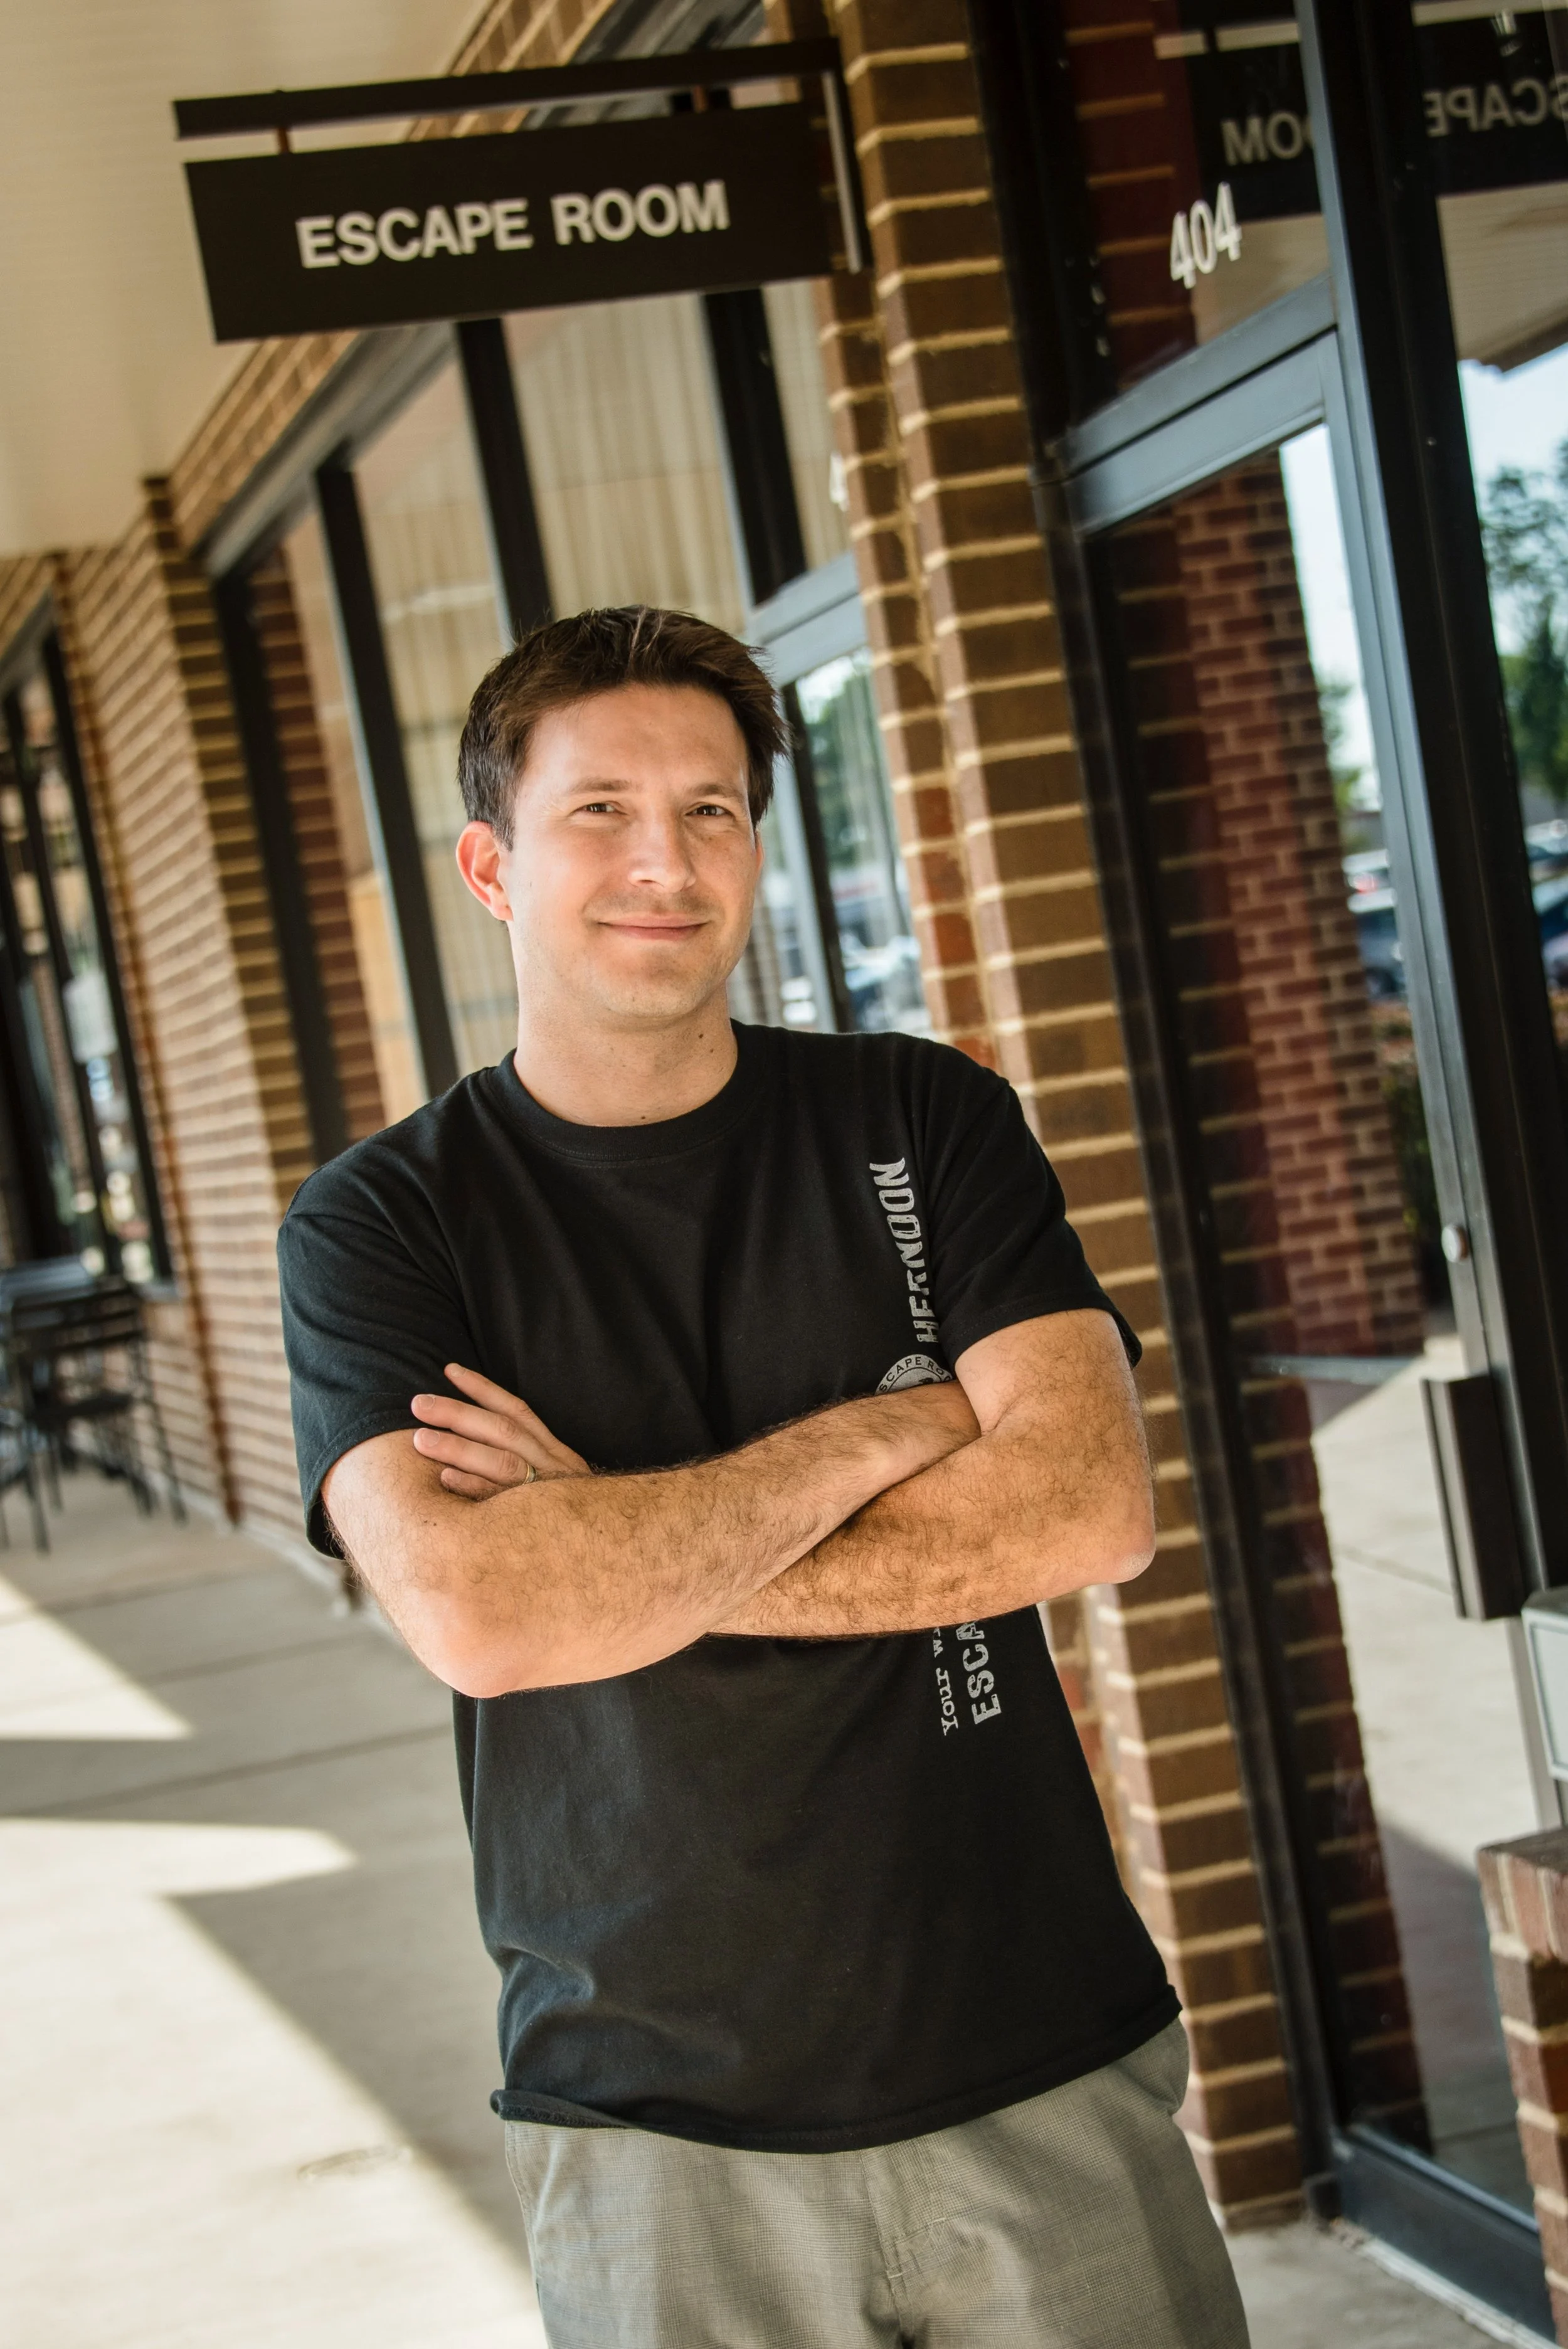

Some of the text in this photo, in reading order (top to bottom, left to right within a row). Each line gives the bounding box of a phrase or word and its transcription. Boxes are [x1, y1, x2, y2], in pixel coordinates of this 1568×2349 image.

[295, 179, 729, 269] ESCAPE ROOM
[1170, 182, 1242, 289] 404
[869, 1157, 940, 1343] HERNDON
[879, 1356, 922, 1392] SCAPE
[935, 1667, 959, 1736] Your
[955, 1621, 1002, 1725] ESCA
